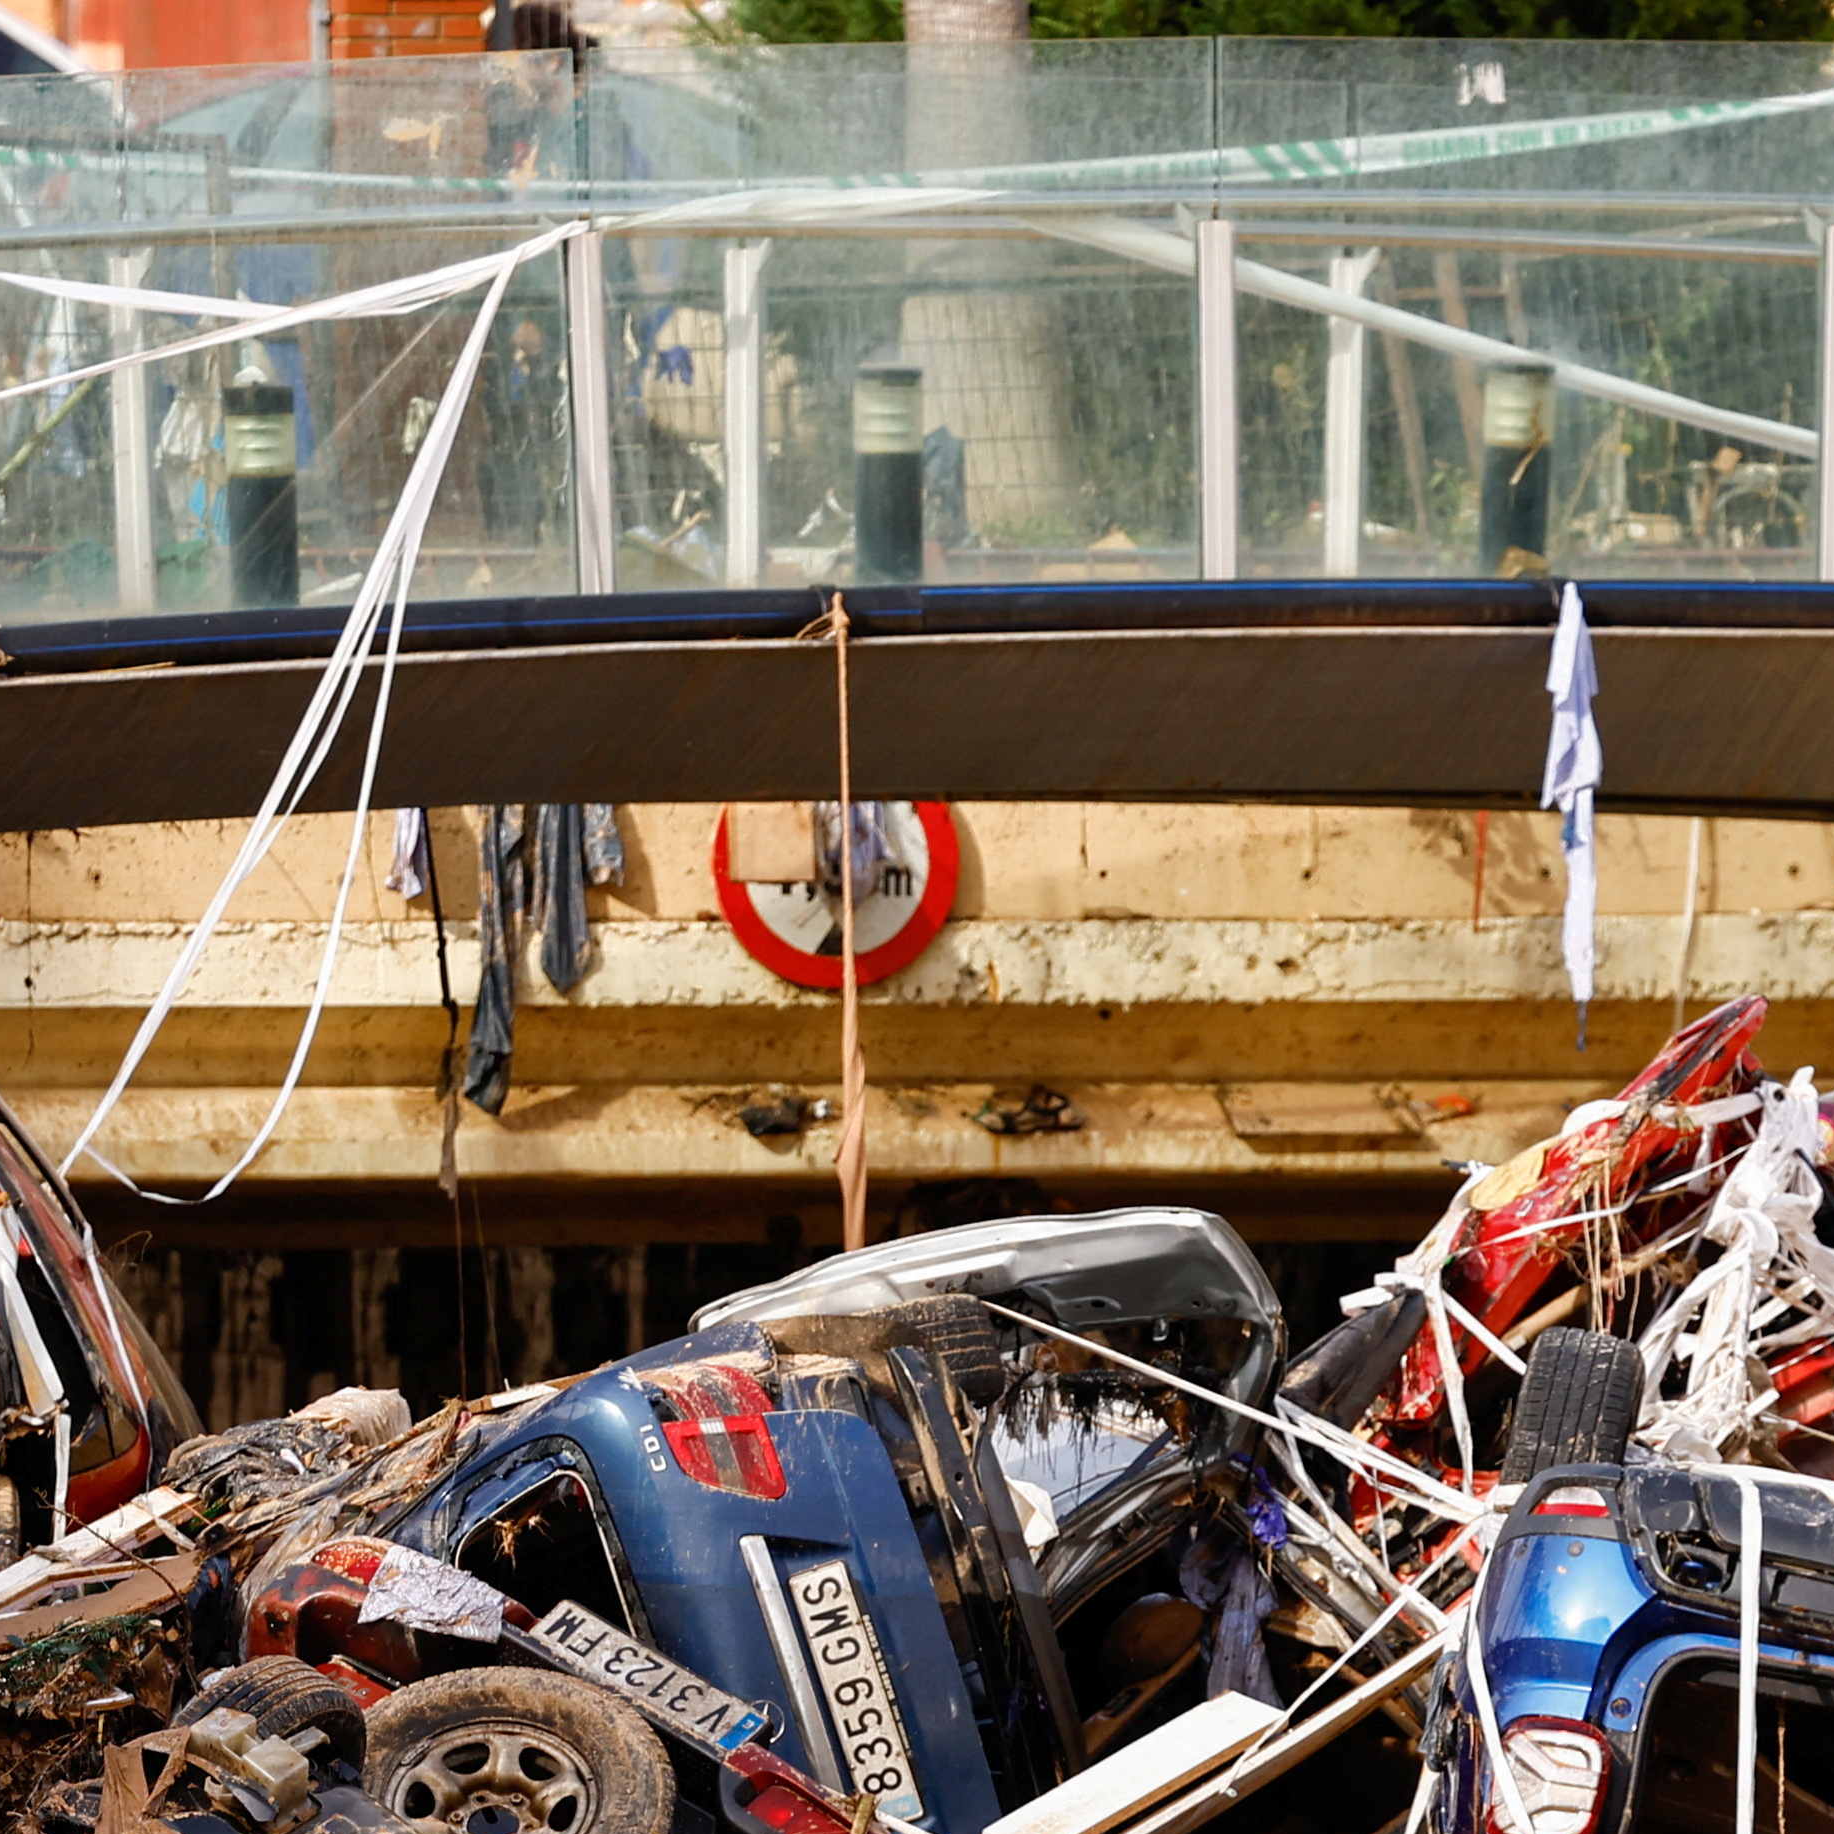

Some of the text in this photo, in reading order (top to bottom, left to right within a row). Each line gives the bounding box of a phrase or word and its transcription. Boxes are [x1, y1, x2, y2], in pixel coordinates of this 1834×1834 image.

[639, 1423, 667, 1473] CDI
[544, 1610, 605, 1660] FM
[603, 1644, 705, 1711] 3123
[803, 1575, 903, 1794] 8359 GMS
[697, 1705, 730, 1735] V
